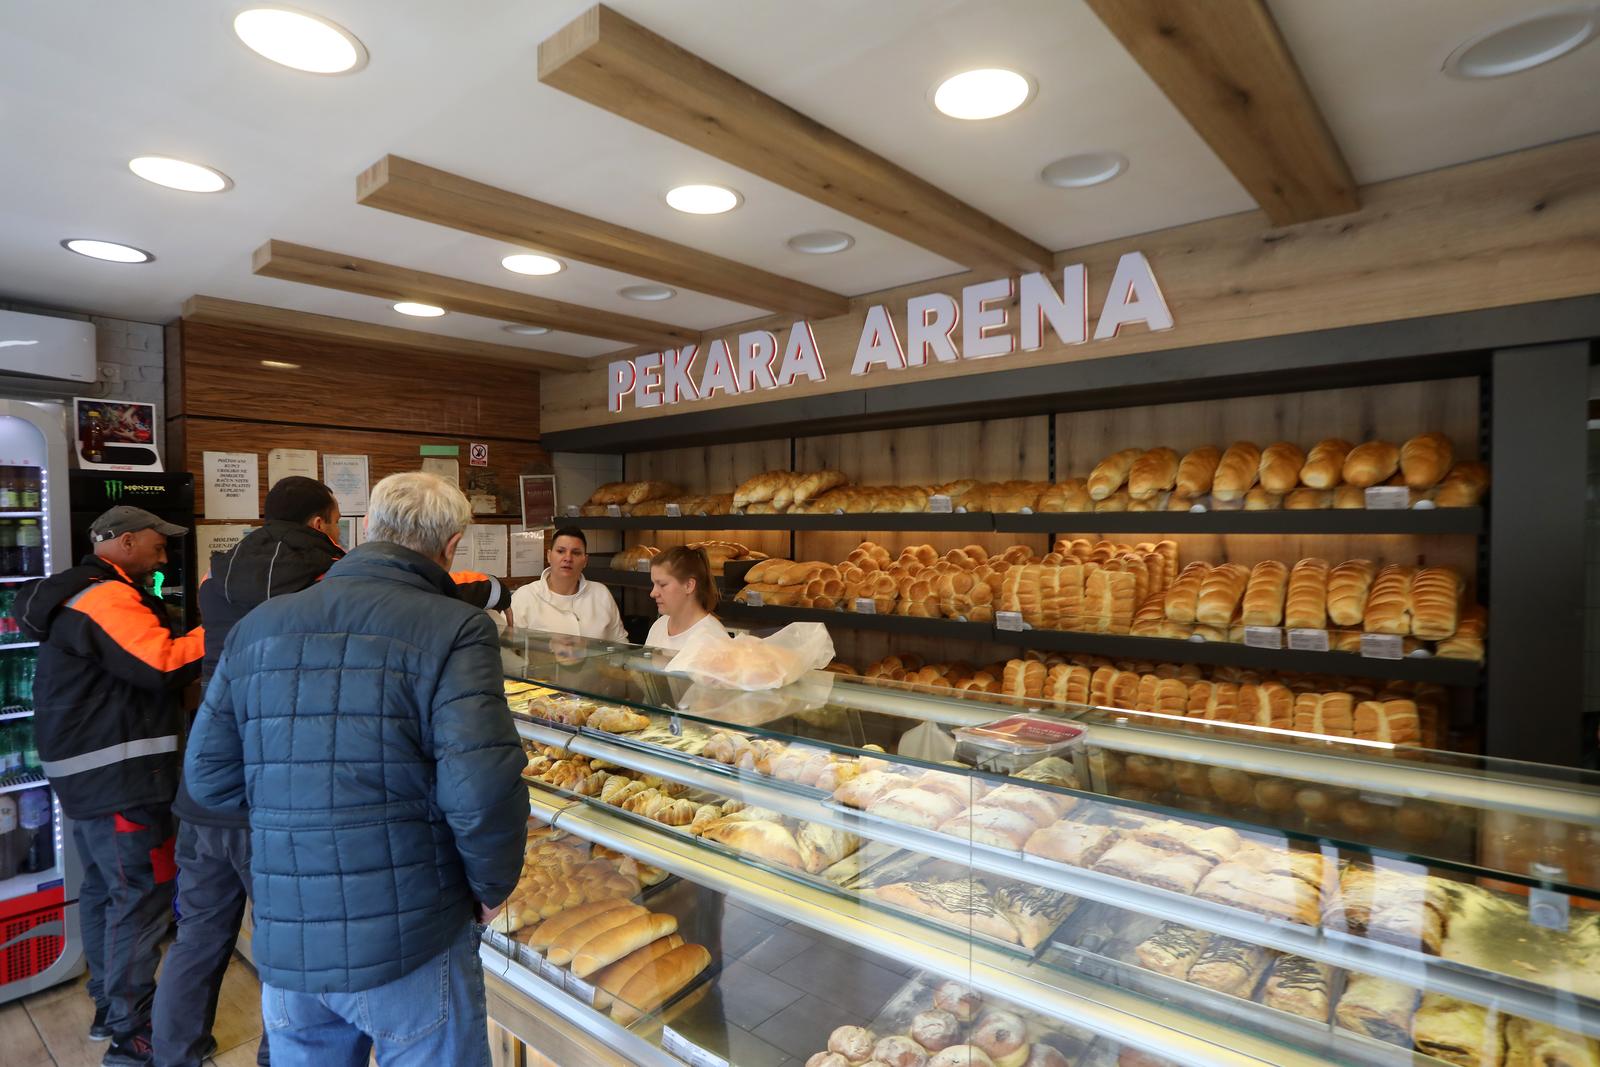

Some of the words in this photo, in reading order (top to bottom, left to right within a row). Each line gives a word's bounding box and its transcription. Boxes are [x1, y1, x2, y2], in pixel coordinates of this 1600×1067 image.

[608, 320, 826, 413] PEKARA
[850, 251, 1175, 376] ARENA
[123, 484, 166, 492] MONSTER
